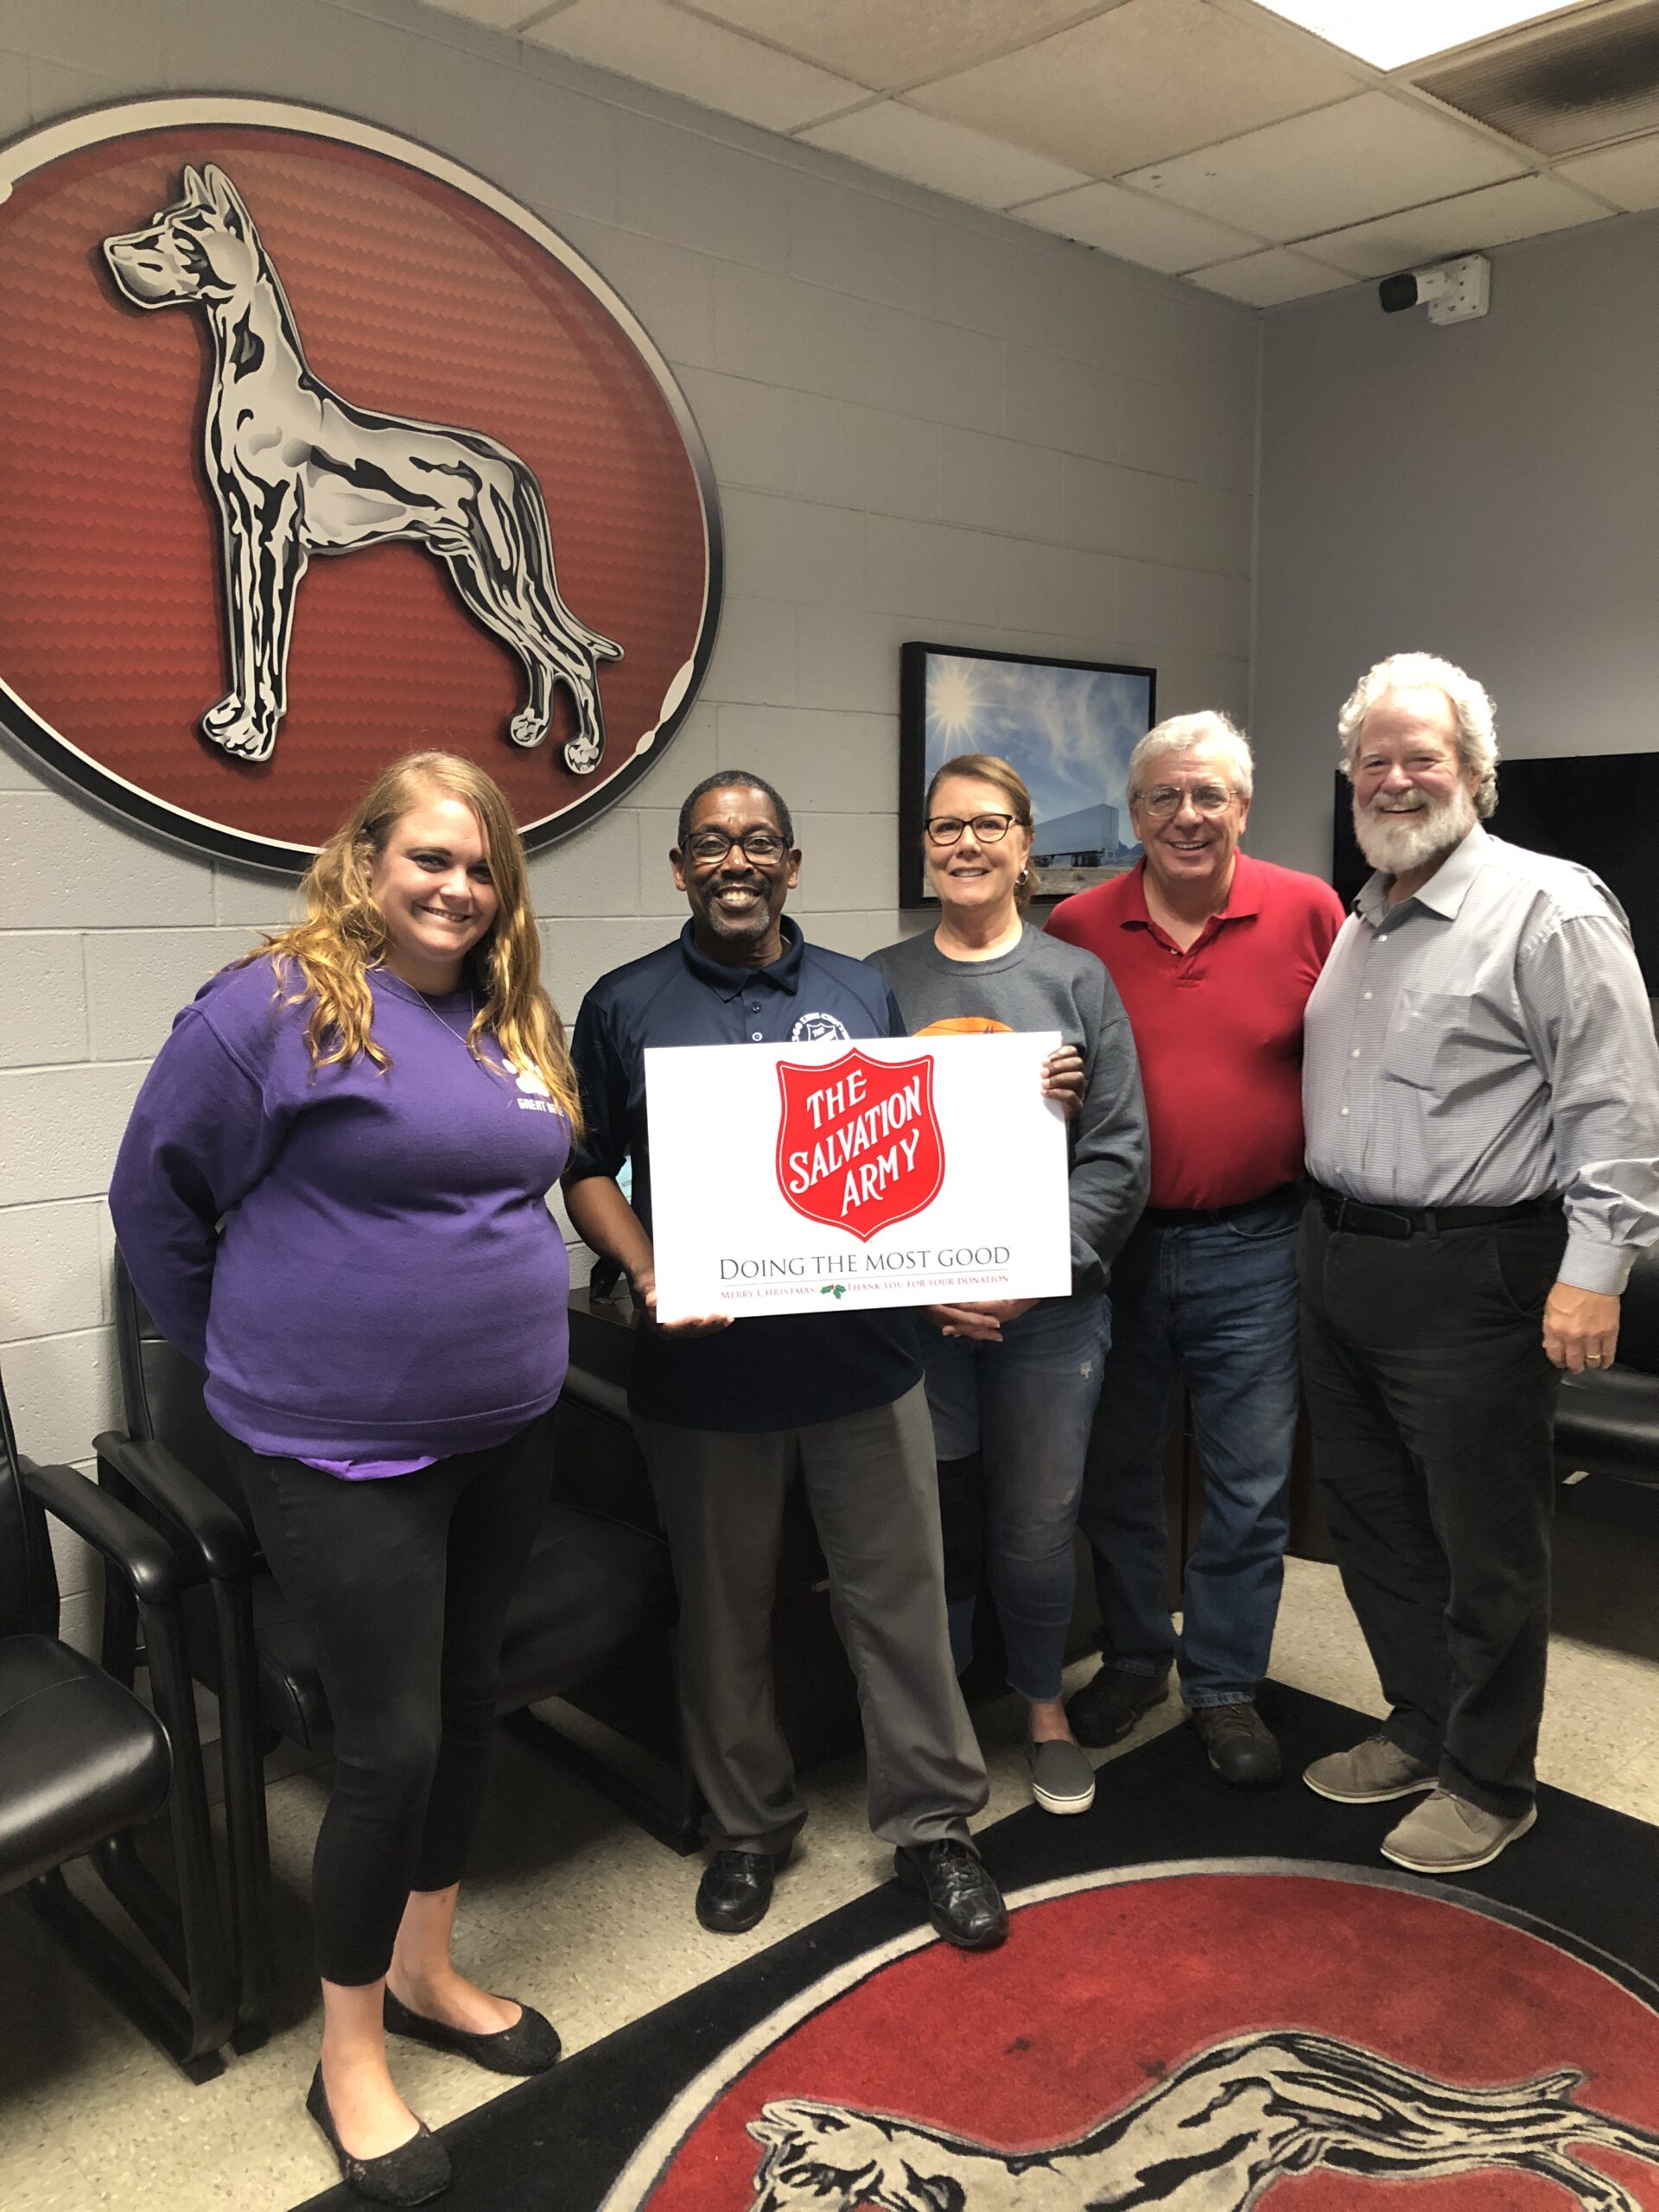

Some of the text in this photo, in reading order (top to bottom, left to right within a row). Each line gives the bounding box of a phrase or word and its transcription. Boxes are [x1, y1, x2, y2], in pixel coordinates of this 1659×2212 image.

[806, 1069, 868, 1129] THE
[789, 1075, 922, 1194] SALVATION
[840, 1128, 920, 1217] ARMY
[720, 1246, 1010, 1281] DOING THE MOST GOOD
[720, 1274, 1009, 1300] MERRY CHRISTMAS THANK YOU FOR YOUR DONATION
